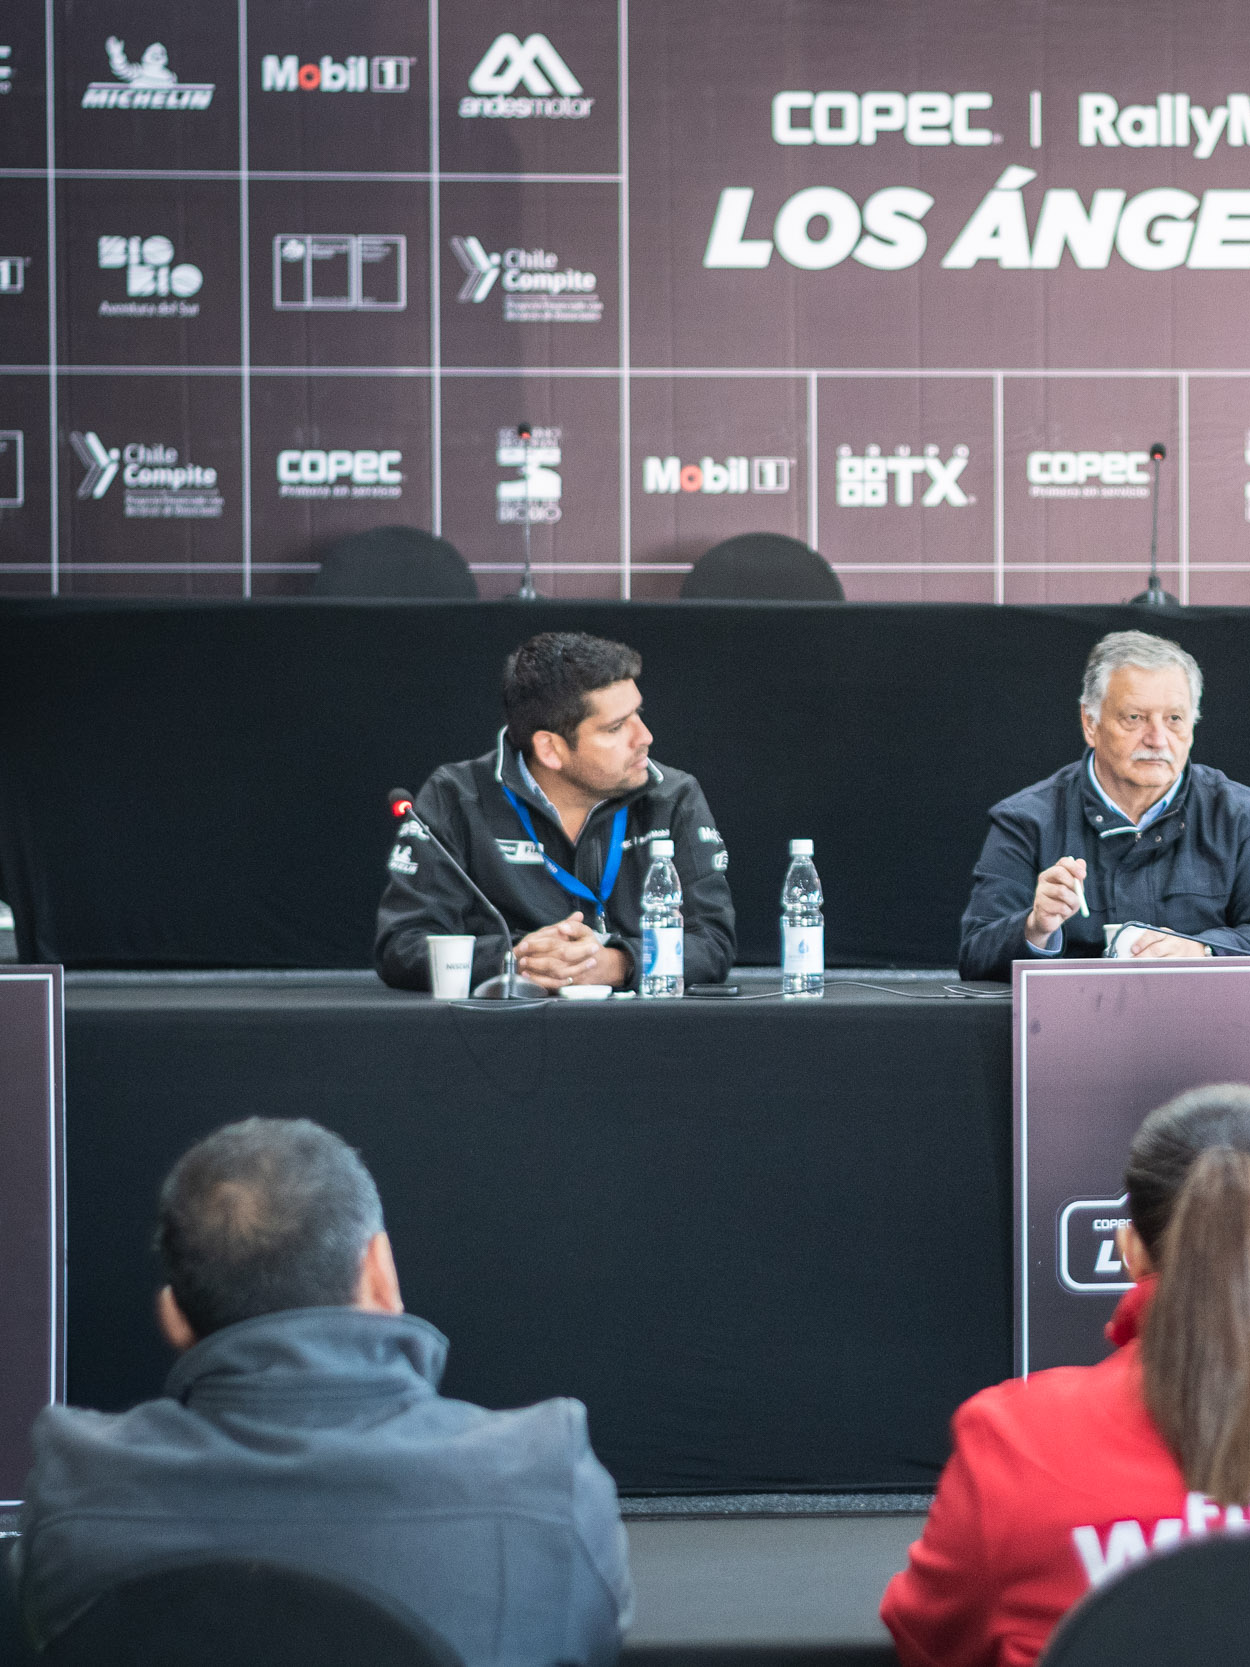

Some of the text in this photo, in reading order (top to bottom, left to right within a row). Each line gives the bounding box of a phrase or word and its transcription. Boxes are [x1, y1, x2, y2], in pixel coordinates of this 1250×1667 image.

[262, 54, 367, 92] Mobil
[82, 89, 214, 109] MICHELIN
[459, 94, 594, 118] andesmotor
[772, 91, 995, 146] COPEC
[703, 187, 934, 270] LOS
[504, 249, 558, 270] Chile
[502, 268, 597, 294] Compite
[123, 443, 178, 466] Chile
[277, 450, 402, 485] COPEC
[1027, 451, 1150, 485] COPEC
[123, 463, 217, 491] Compite
[643, 456, 748, 494] Mobil
